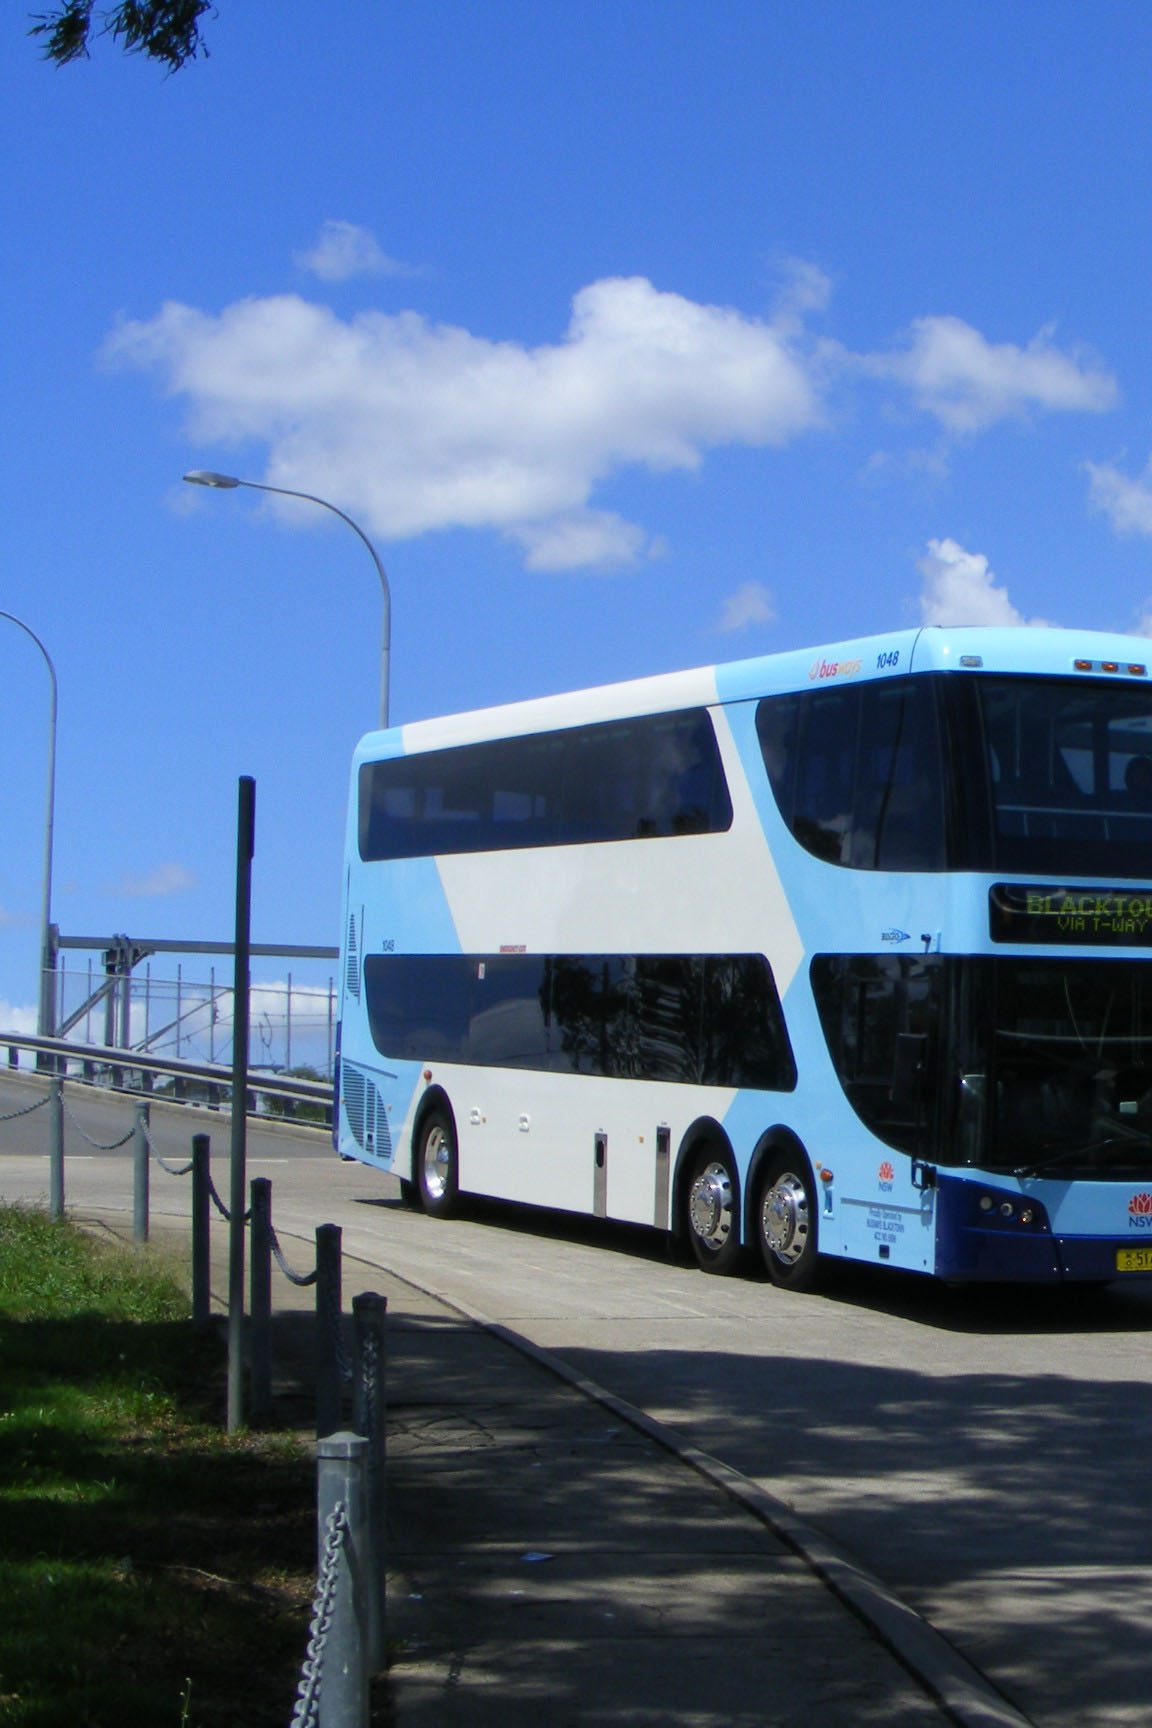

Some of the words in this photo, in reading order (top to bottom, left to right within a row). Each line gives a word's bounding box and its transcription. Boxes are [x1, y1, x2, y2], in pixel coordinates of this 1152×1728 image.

[819, 658, 862, 678] busways
[876, 650, 900, 669] 1048
[1057, 916, 1085, 931] VIA
[1092, 917, 1148, 933] T-WAY
[879, 1182, 893, 1192] NSW
